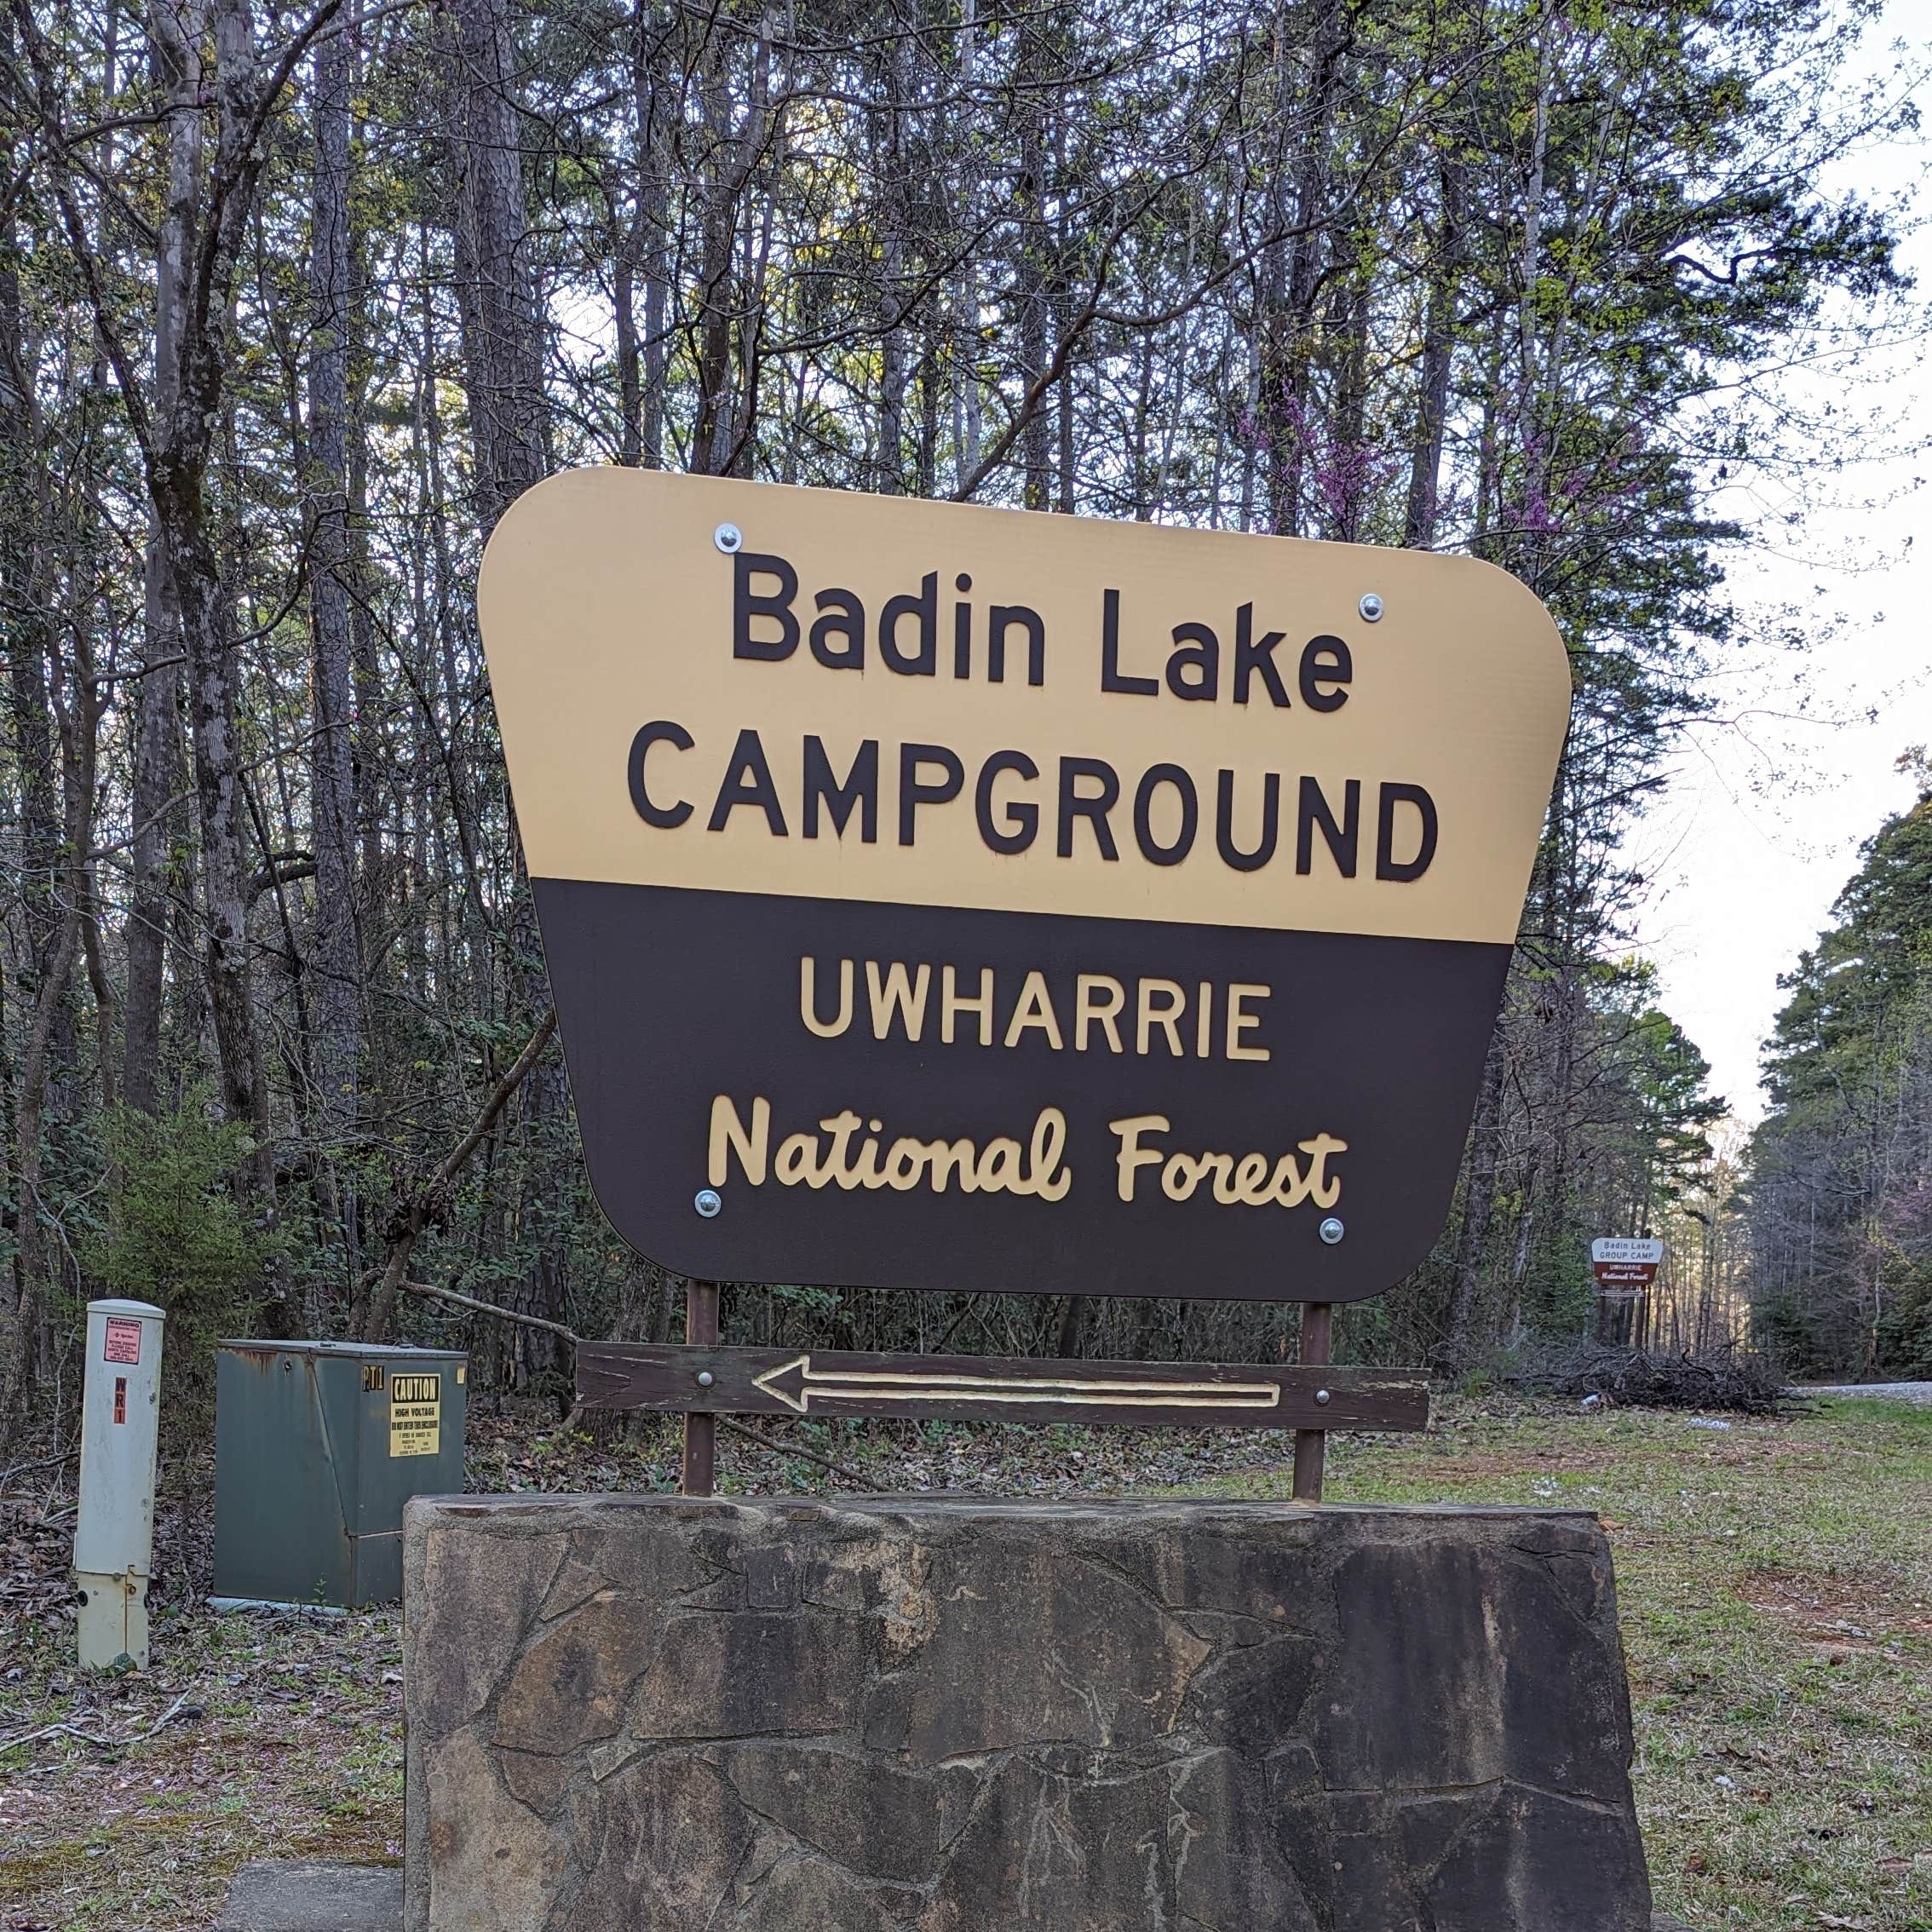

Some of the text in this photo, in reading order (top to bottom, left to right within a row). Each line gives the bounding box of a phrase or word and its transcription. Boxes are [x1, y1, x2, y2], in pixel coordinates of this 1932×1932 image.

[733, 552, 1353, 712] Badin Lake
[627, 720, 1438, 882] CAMPGROUND
[801, 957, 1271, 1061] UWHARRIE
[708, 1095, 1348, 1208] National Forest
[1604, 1241, 1628, 1250] Badin
[394, 1378, 436, 1400] CAUTION
[395, 1407, 434, 1417] HIGH VOLTAGE
